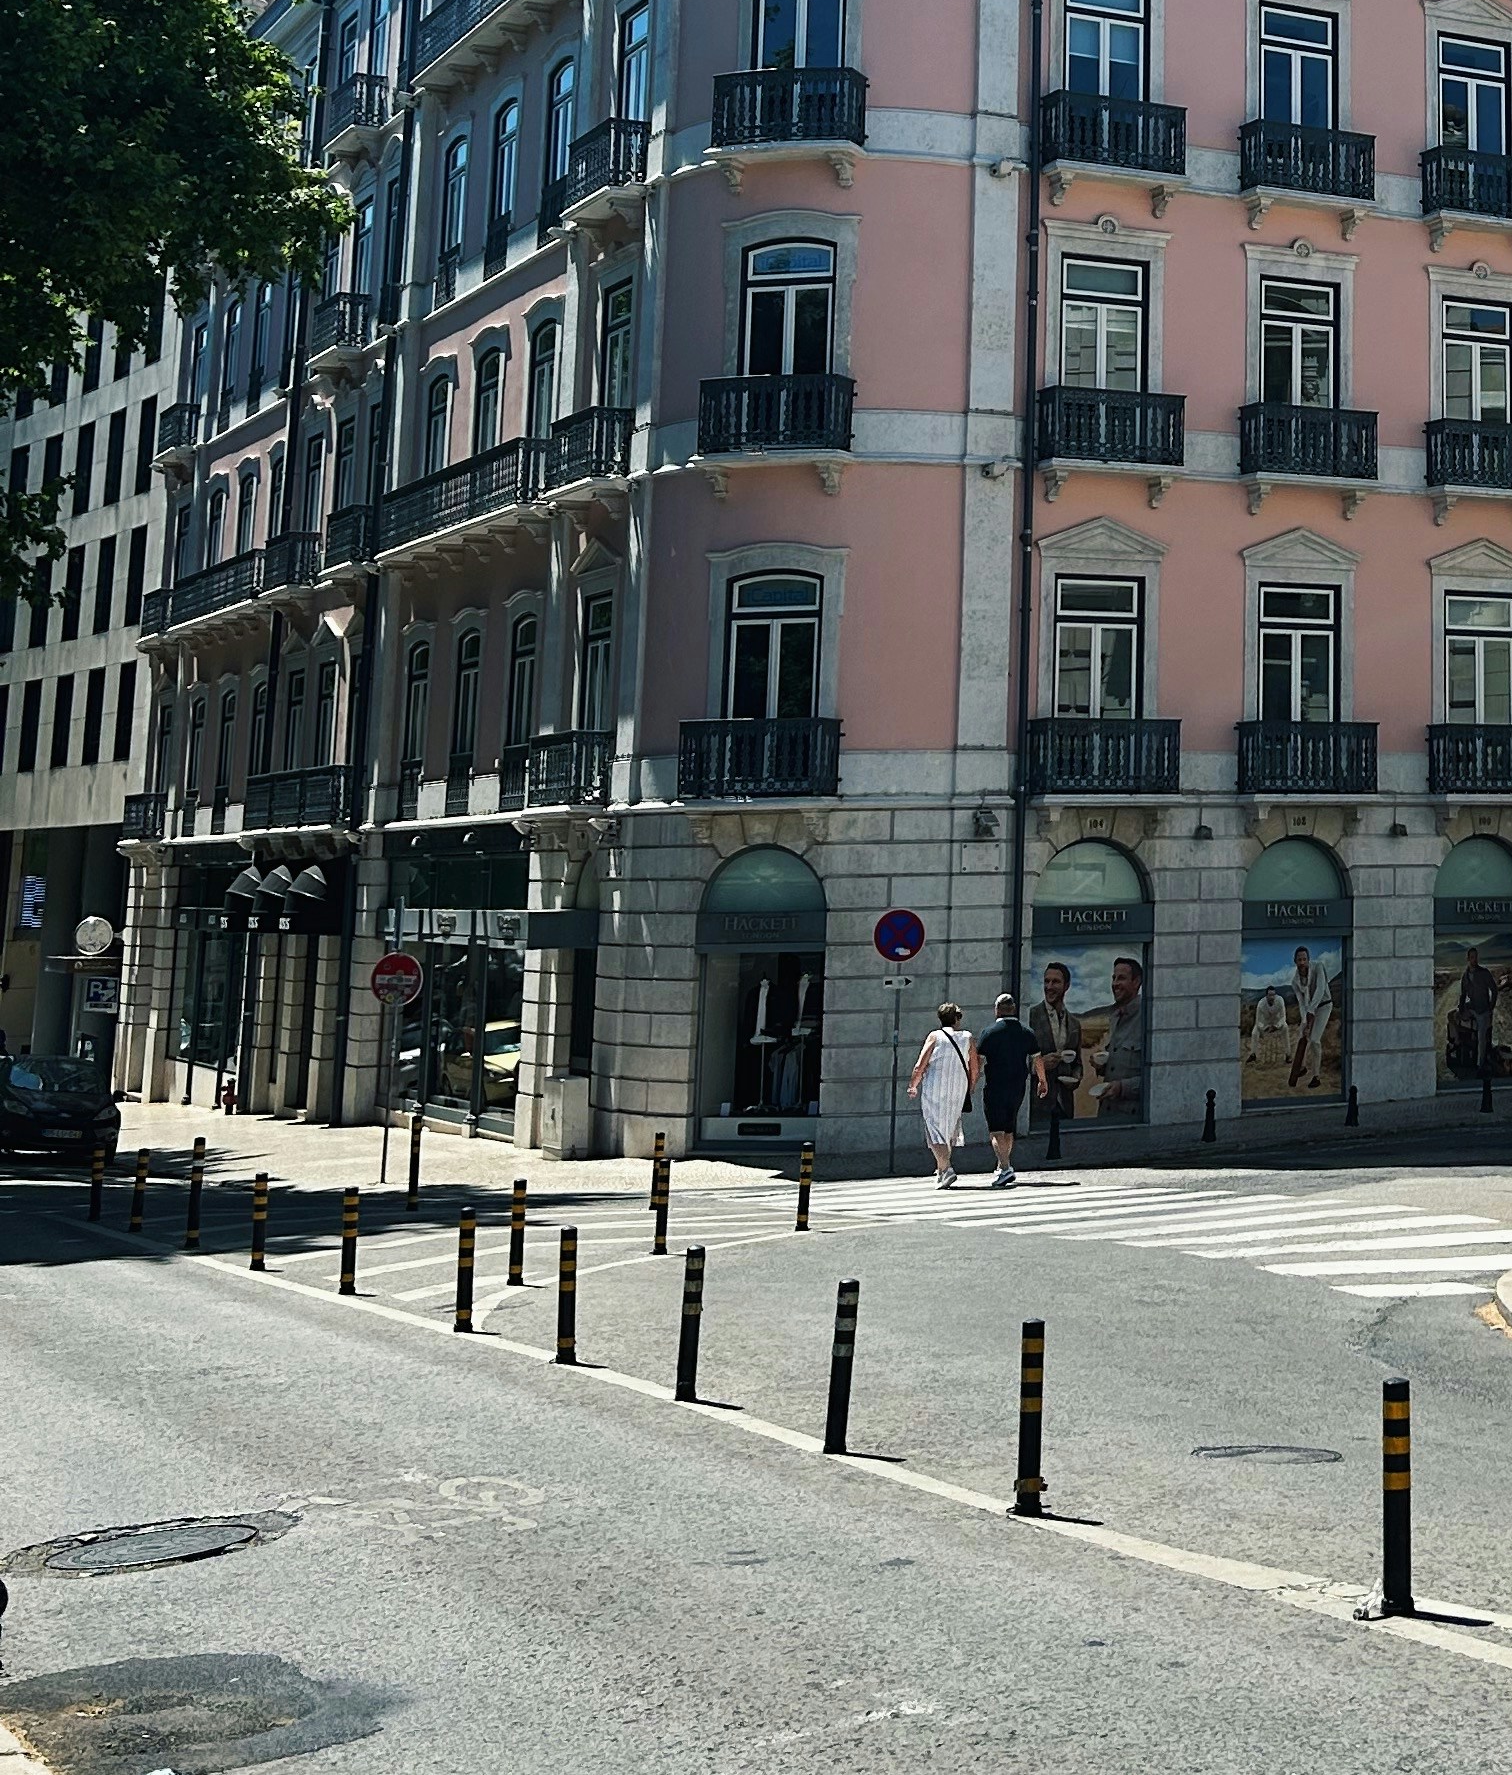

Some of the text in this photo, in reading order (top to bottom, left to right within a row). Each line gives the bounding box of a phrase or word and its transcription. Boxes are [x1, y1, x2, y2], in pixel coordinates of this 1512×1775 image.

[1060, 909, 1127, 923] HACKETT
[1267, 904, 1328, 916] HACKETT
[723, 916, 798, 931] HACKETT
